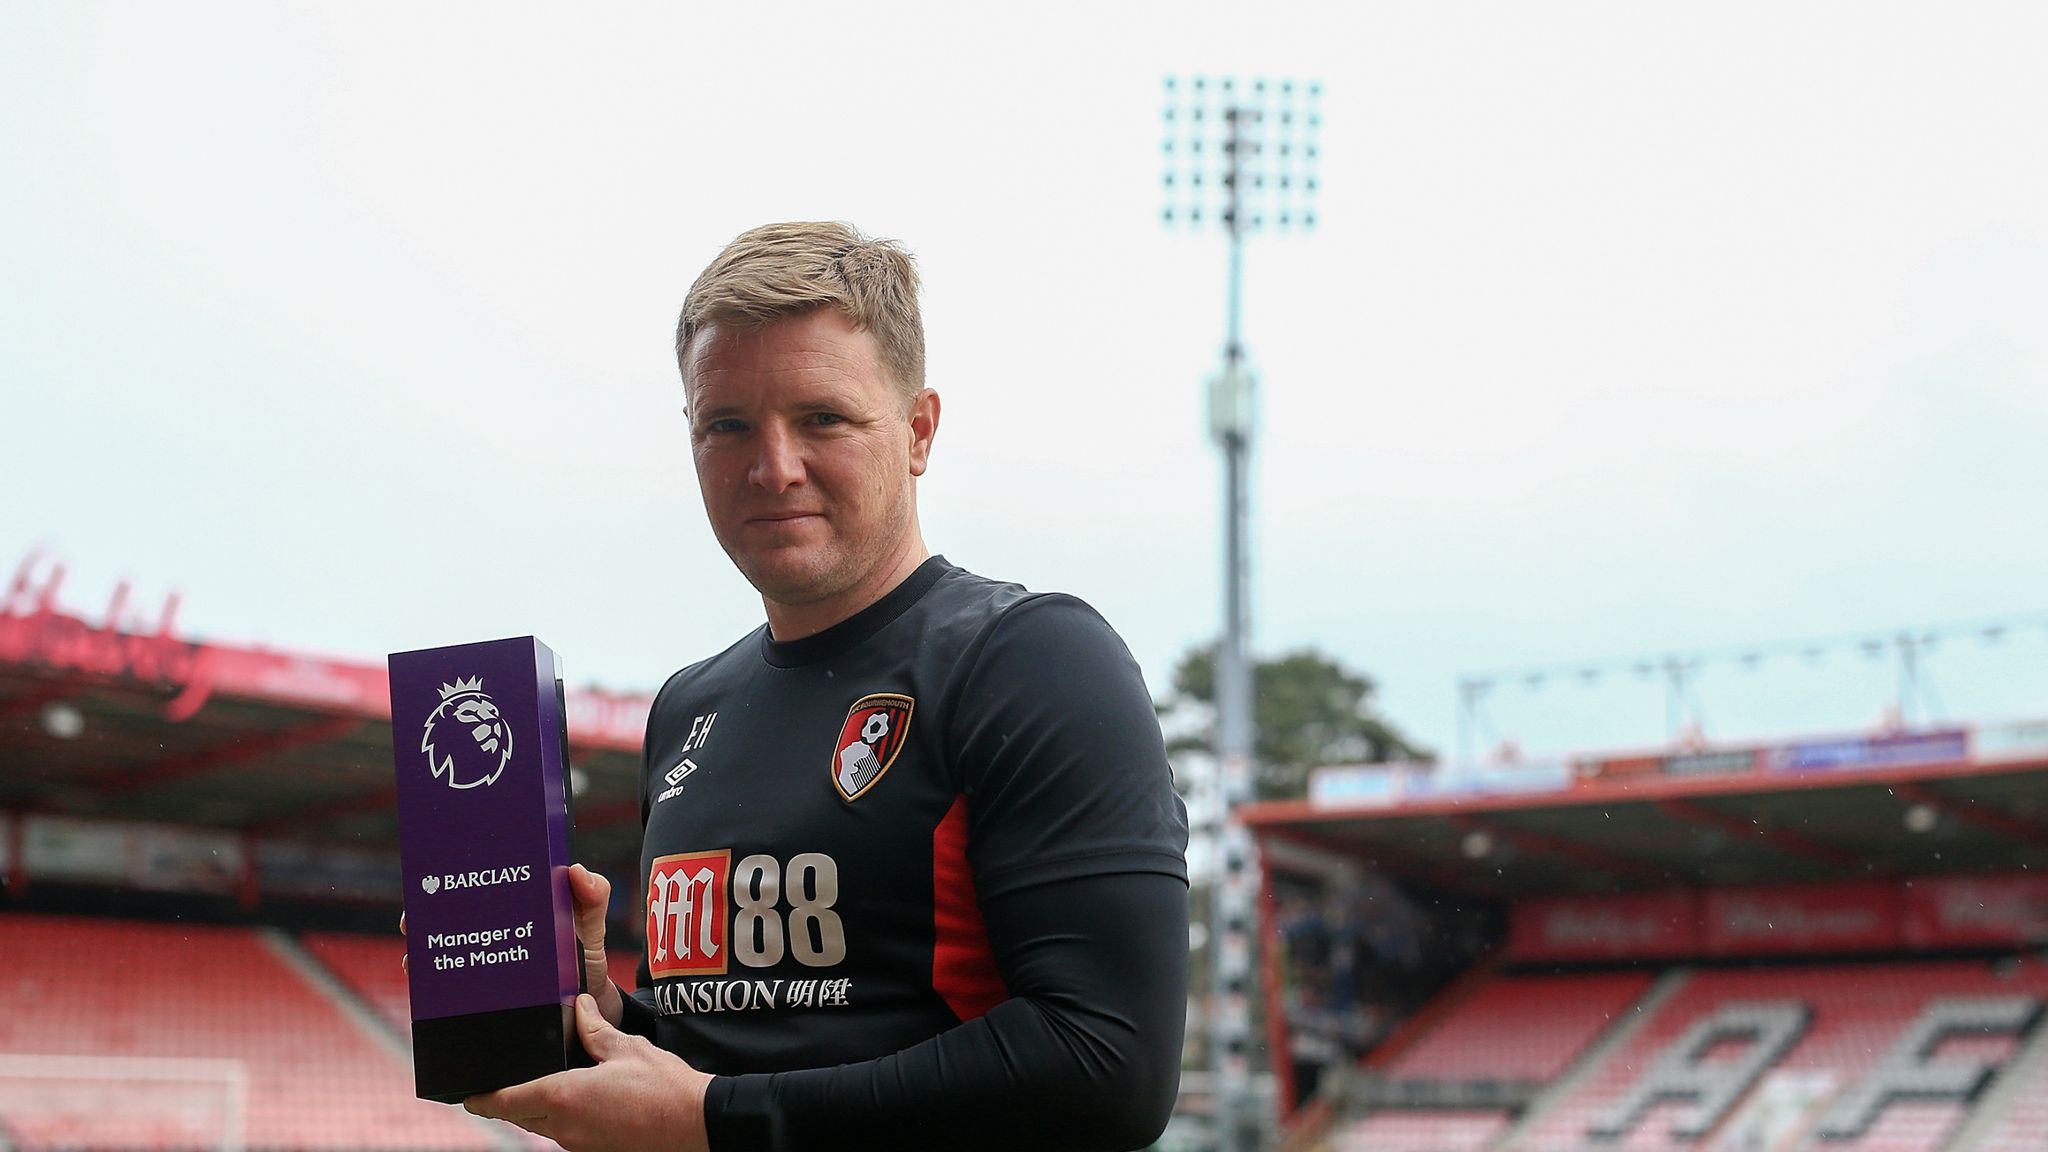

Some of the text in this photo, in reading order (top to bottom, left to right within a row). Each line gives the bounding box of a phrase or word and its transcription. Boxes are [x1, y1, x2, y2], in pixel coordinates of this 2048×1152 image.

[681, 712, 718, 753] EH
[657, 785, 684, 803] umbro
[444, 865, 531, 891] BARCLAYS
[427, 921, 534, 950] Manager of
[433, 945, 530, 971] the Month
[653, 979, 785, 1017] MANSION
